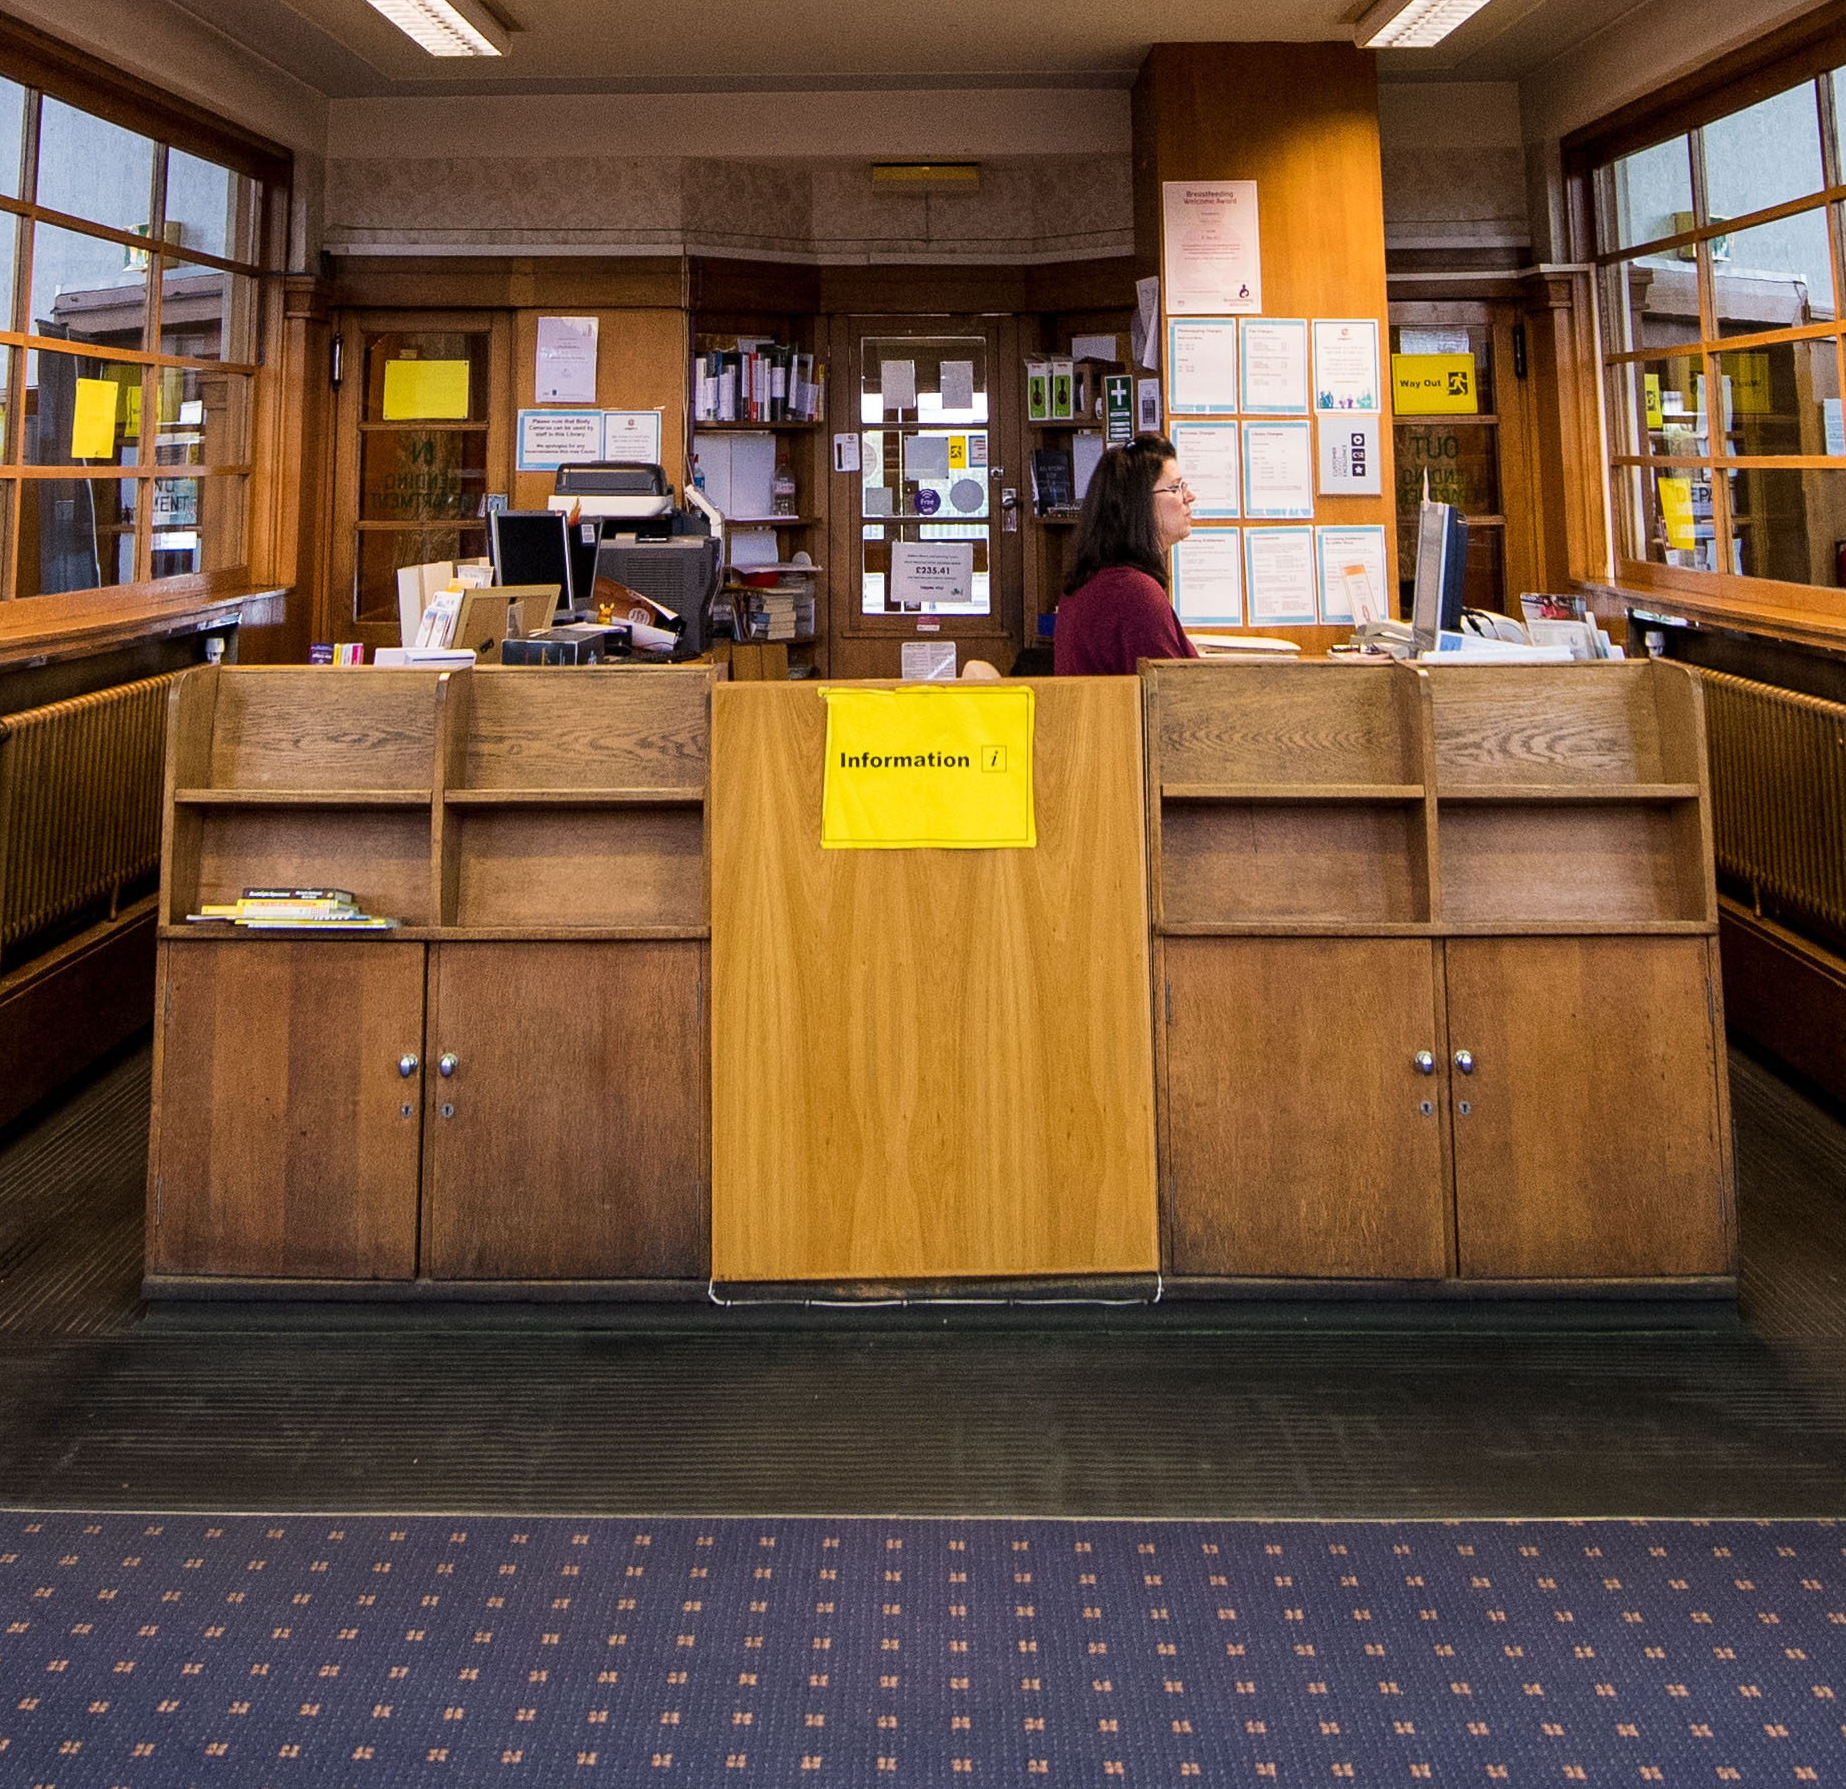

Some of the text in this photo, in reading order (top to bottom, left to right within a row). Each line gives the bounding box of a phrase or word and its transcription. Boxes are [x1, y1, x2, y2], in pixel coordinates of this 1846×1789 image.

[1400, 379, 1441, 389] Way Out
[916, 566, 950, 574] £235.41
[840, 752, 970, 768] Information
